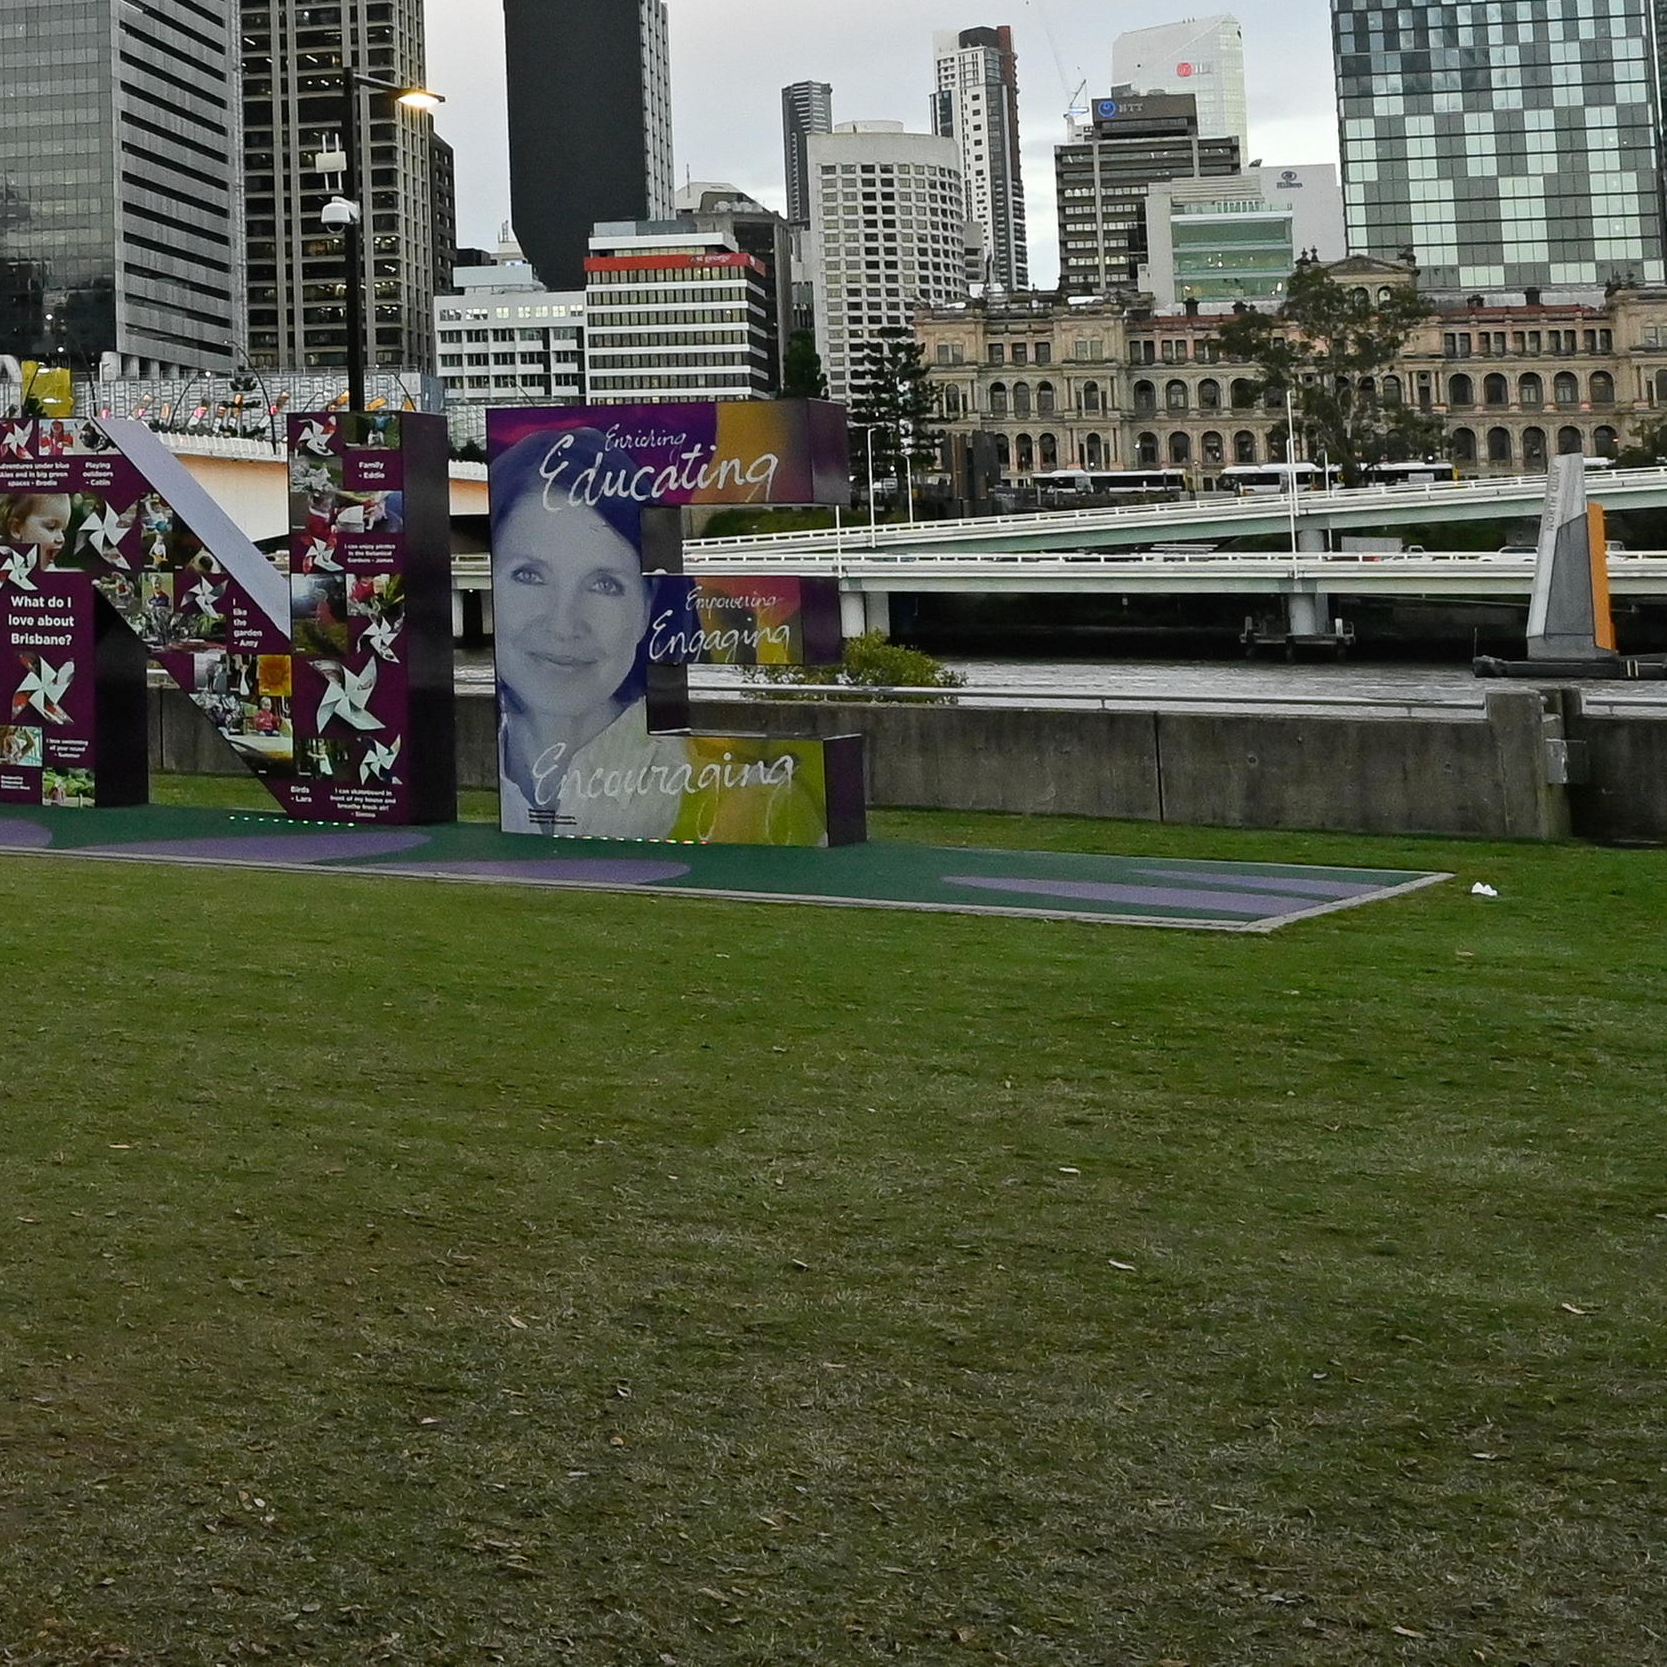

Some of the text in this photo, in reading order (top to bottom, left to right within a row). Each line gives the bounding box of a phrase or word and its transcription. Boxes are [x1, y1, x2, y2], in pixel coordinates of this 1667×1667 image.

[604, 423, 686, 460] Enriching
[34, 462, 54, 470] under
[55, 461, 70, 469] blue
[85, 461, 111, 470] Playing
[358, 461, 384, 470] Family
[36, 471, 47, 479] big
[48, 471, 68, 479] green
[82, 470, 114, 478] outdoors
[539, 434, 779, 512] Educating
[8, 479, 30, 487] spaces
[10, 595, 72, 608] What do I
[685, 586, 777, 618] Empowering
[233, 607, 247, 616] like
[8, 613, 75, 627] love about
[233, 618, 247, 626] the
[233, 628, 263, 638] garden
[649, 609, 791, 663] Engaging
[11, 632, 72, 646] Brisbane?
[239, 639, 258, 648] Amy
[290, 785, 310, 794] Birds
[532, 742, 795, 828] Encouraging
[295, 795, 312, 803] Lara
